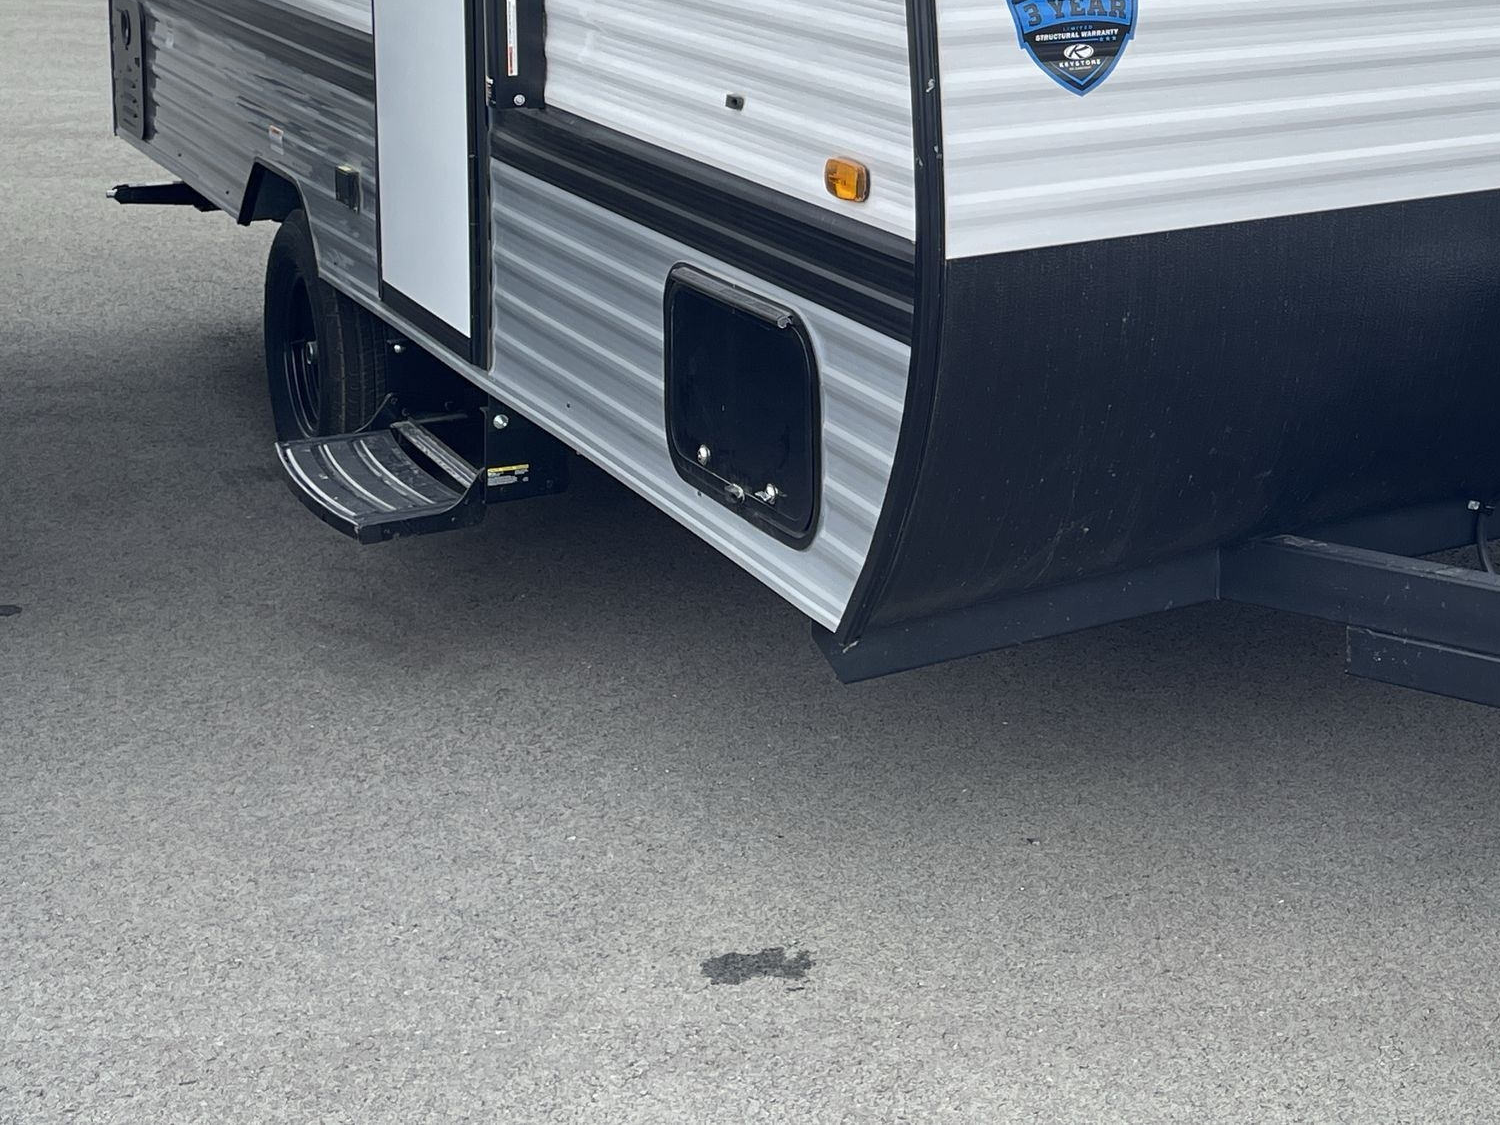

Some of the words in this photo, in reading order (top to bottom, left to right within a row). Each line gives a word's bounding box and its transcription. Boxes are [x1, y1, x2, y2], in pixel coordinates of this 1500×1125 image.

[1022, 2, 1043, 27] 3
[1035, 32, 1080, 42] STRUCTURAL
[1080, 28, 1119, 38] WARRANTY
